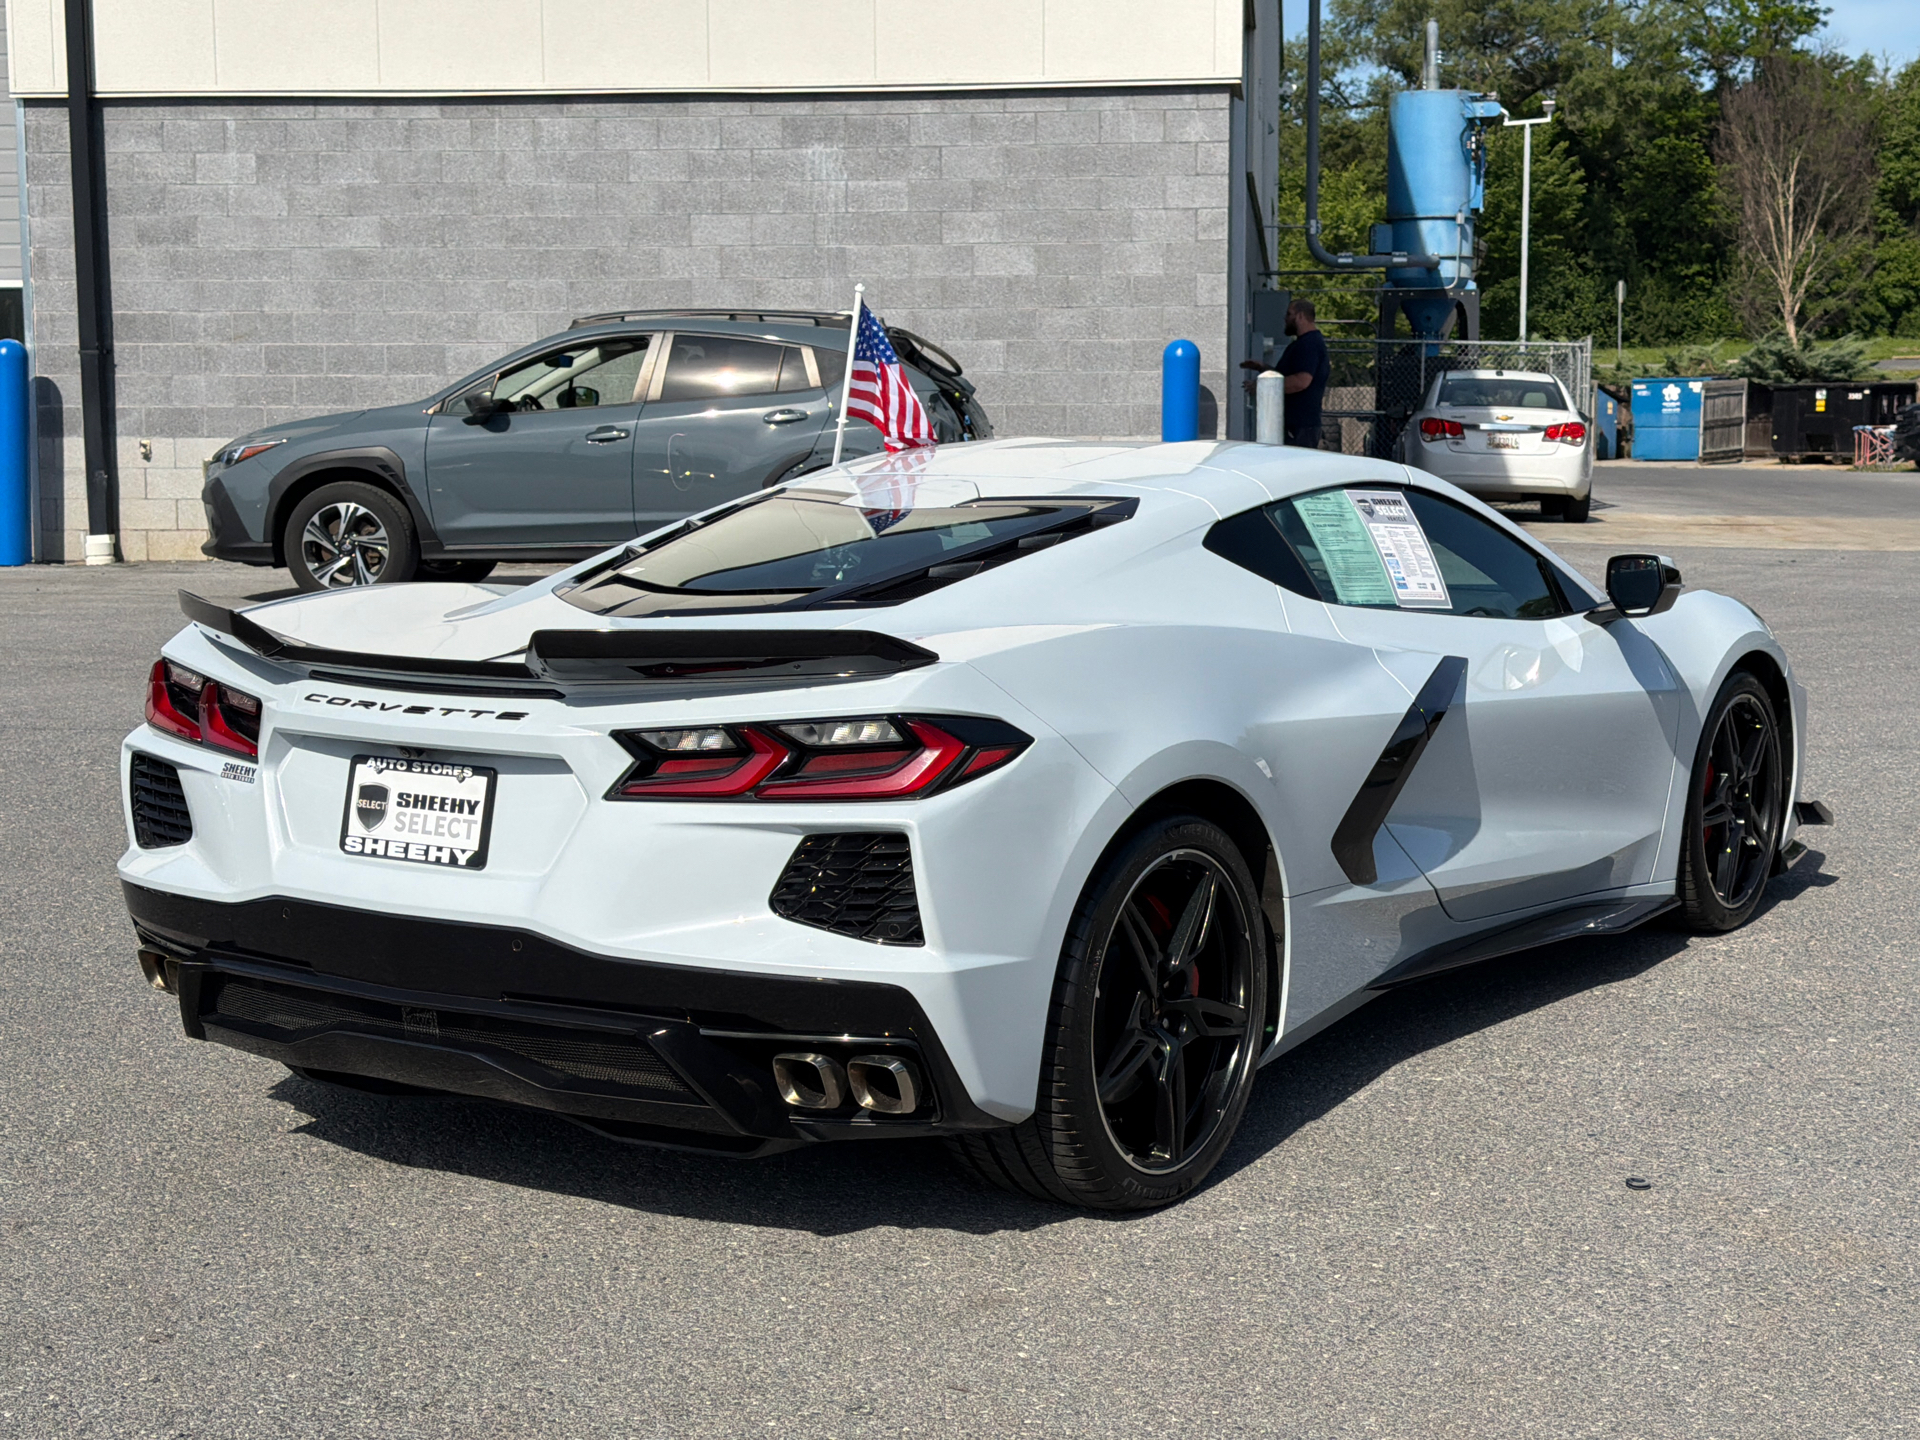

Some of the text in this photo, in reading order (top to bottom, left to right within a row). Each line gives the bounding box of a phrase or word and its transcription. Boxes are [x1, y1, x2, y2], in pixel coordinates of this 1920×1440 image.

[1371, 498, 1403, 506] SHEEHY
[1375, 505, 1407, 516] SELECT
[304, 693, 530, 721] CORVETTE
[222, 762, 257, 777] SHEEHY
[366, 757, 473, 778] AUTO STORES
[357, 799, 387, 811] SELECT
[396, 792, 481, 815] SHEEHY
[394, 811, 478, 840] SELECT
[344, 836, 476, 866] SHEEHY
